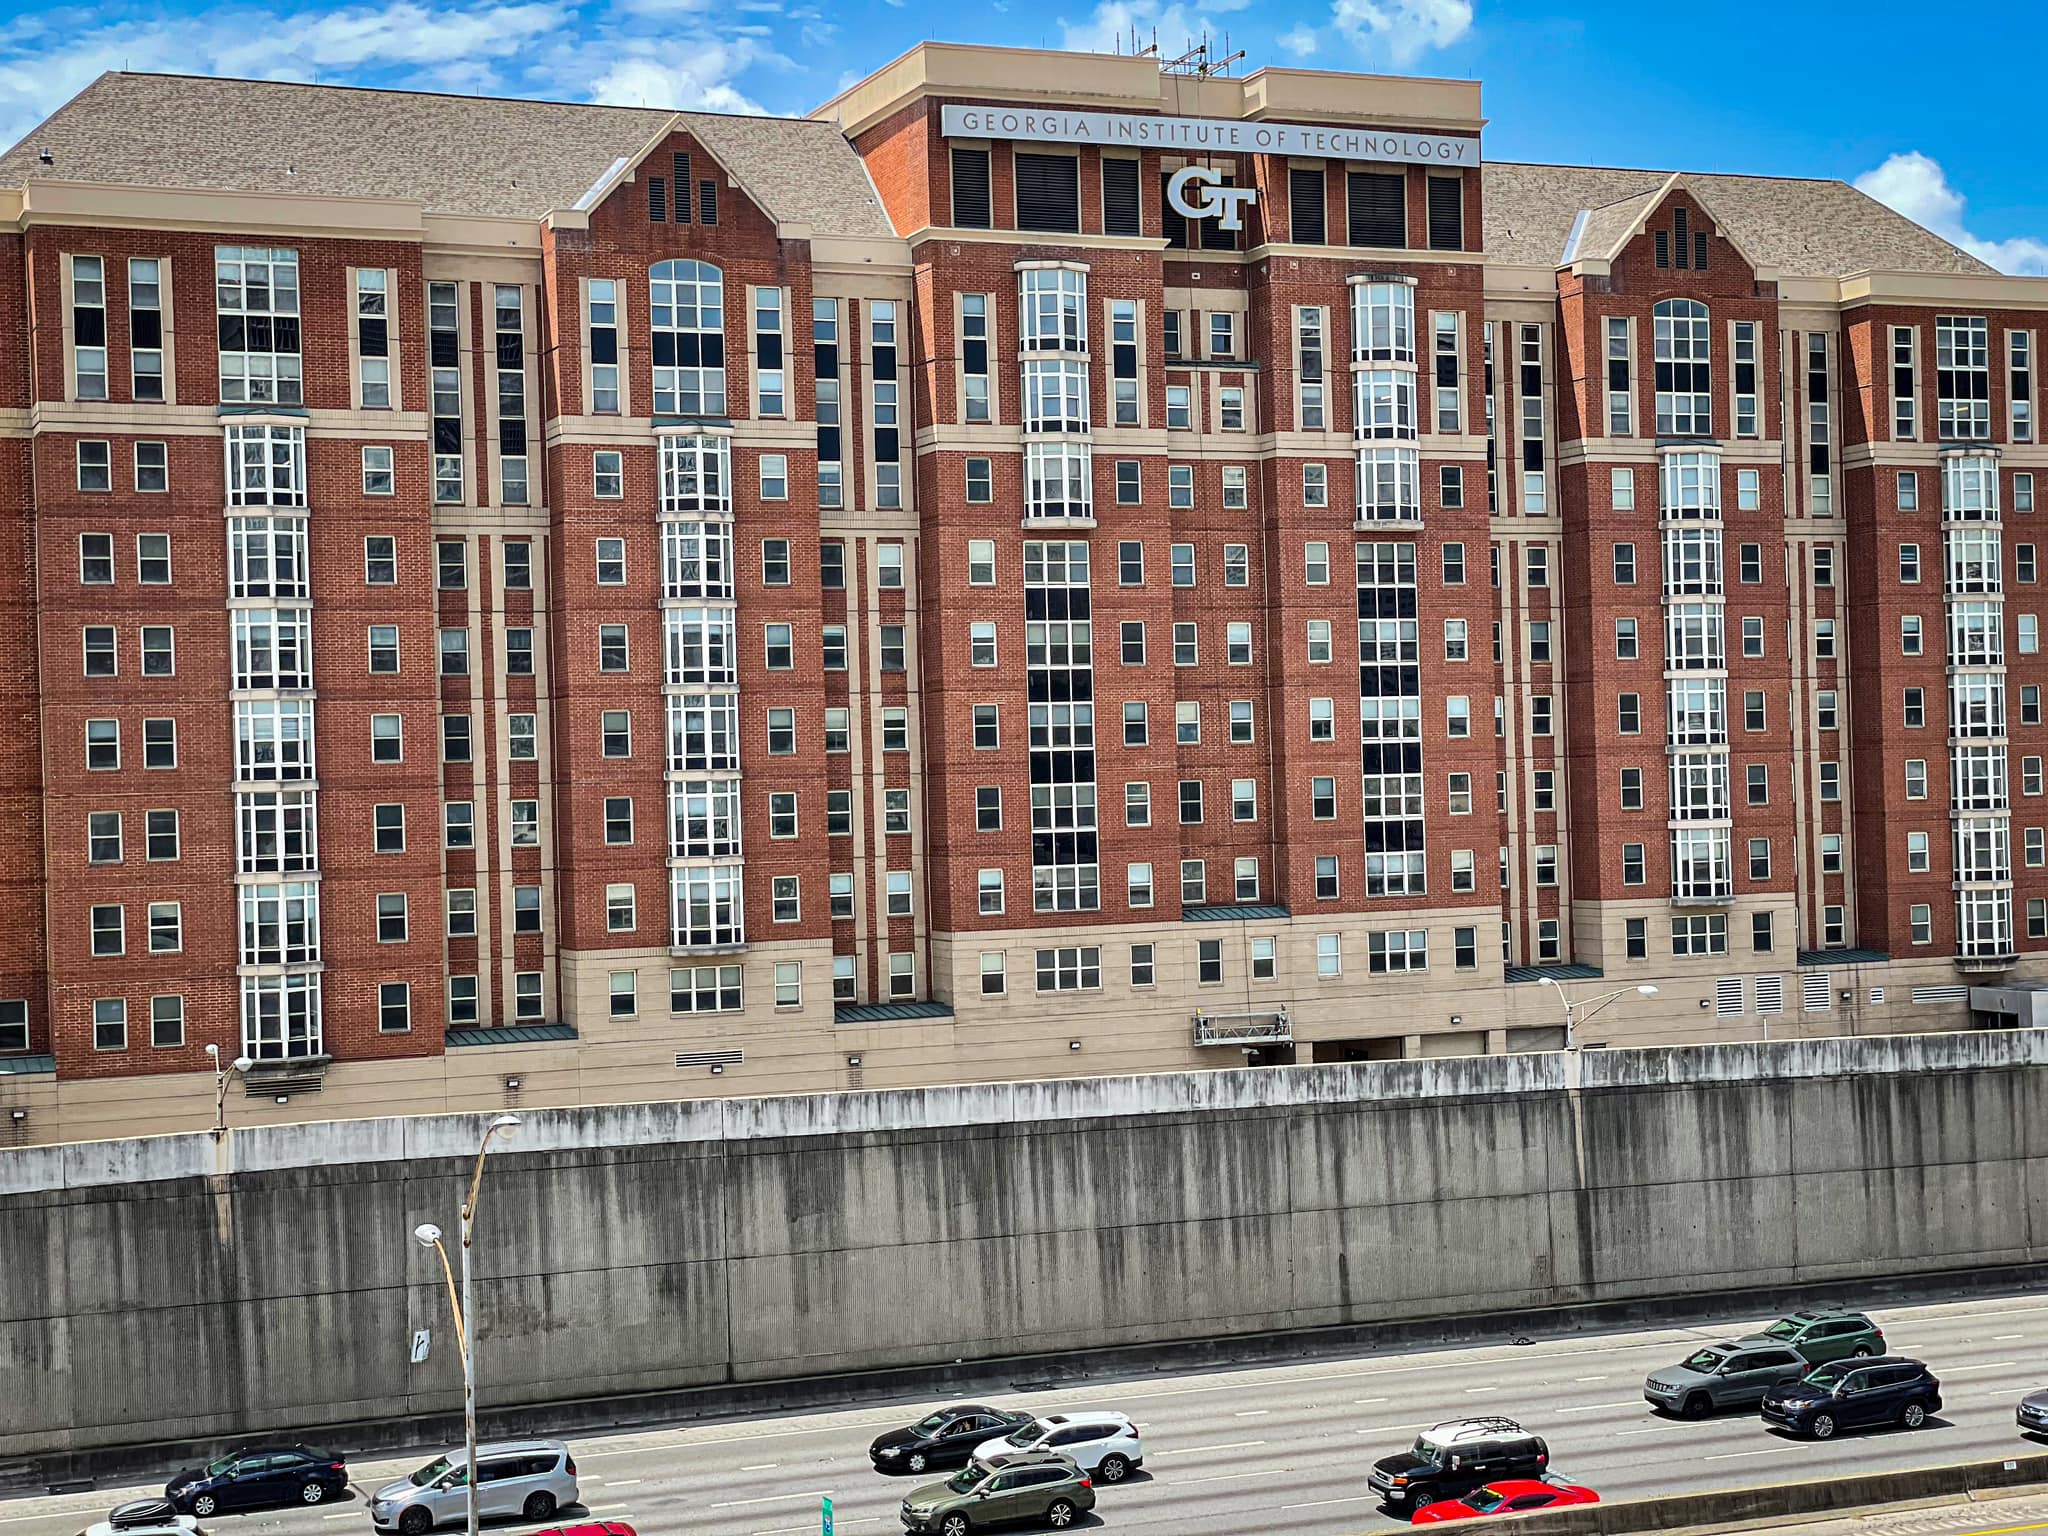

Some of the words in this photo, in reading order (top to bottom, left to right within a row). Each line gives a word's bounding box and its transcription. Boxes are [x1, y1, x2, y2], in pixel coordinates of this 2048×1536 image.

[962, 112, 1091, 137] GEORGIA
[1108, 120, 1240, 145] INSTITUTE
[1255, 129, 1286, 147] OF
[1300, 132, 1465, 160] TECHNOLOGY
[1167, 165, 1257, 231] GT
